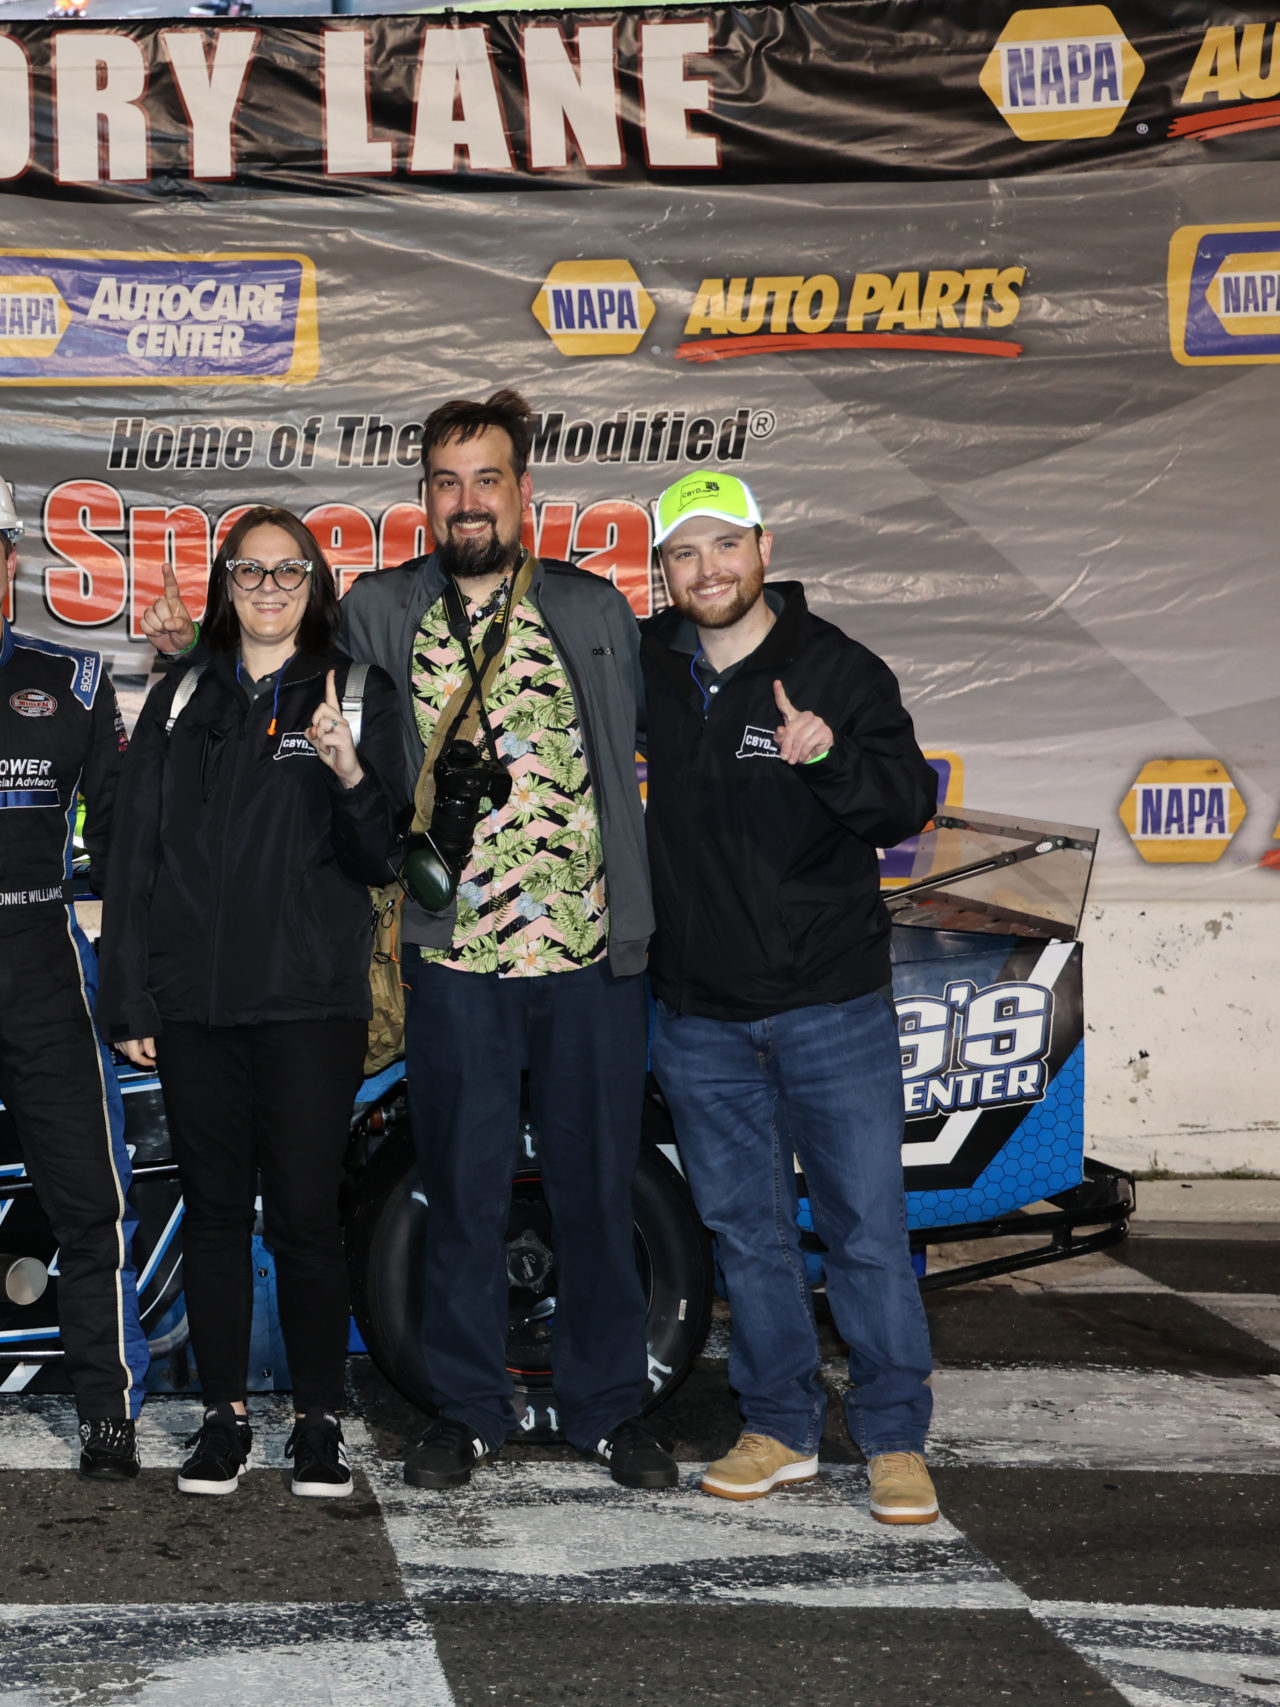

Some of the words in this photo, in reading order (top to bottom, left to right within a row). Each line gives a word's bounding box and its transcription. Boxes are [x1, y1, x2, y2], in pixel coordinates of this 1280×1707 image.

[1006, 42, 1120, 107] NAPA
[1181, 23, 1280, 104] AU
[323, 19, 721, 177] LANE
[552, 289, 639, 330] NAPA
[684, 274, 838, 335] AUTO
[847, 266, 1025, 331] PARTS
[1223, 273, 1280, 314] NAP
[127, 325, 245, 358] CENTER
[107, 416, 254, 470] Home
[266, 415, 324, 470] of
[335, 414, 423, 468] The
[80, 656, 95, 693] sparco
[282, 739, 310, 749] CBYD
[745, 734, 772, 750] CBYD
[15, 776, 57, 789] Advisory
[1140, 787, 1227, 835] NAPA
[28, 885, 63, 904] WILLIAMS
[902, 1063, 1040, 1112] ENTER
